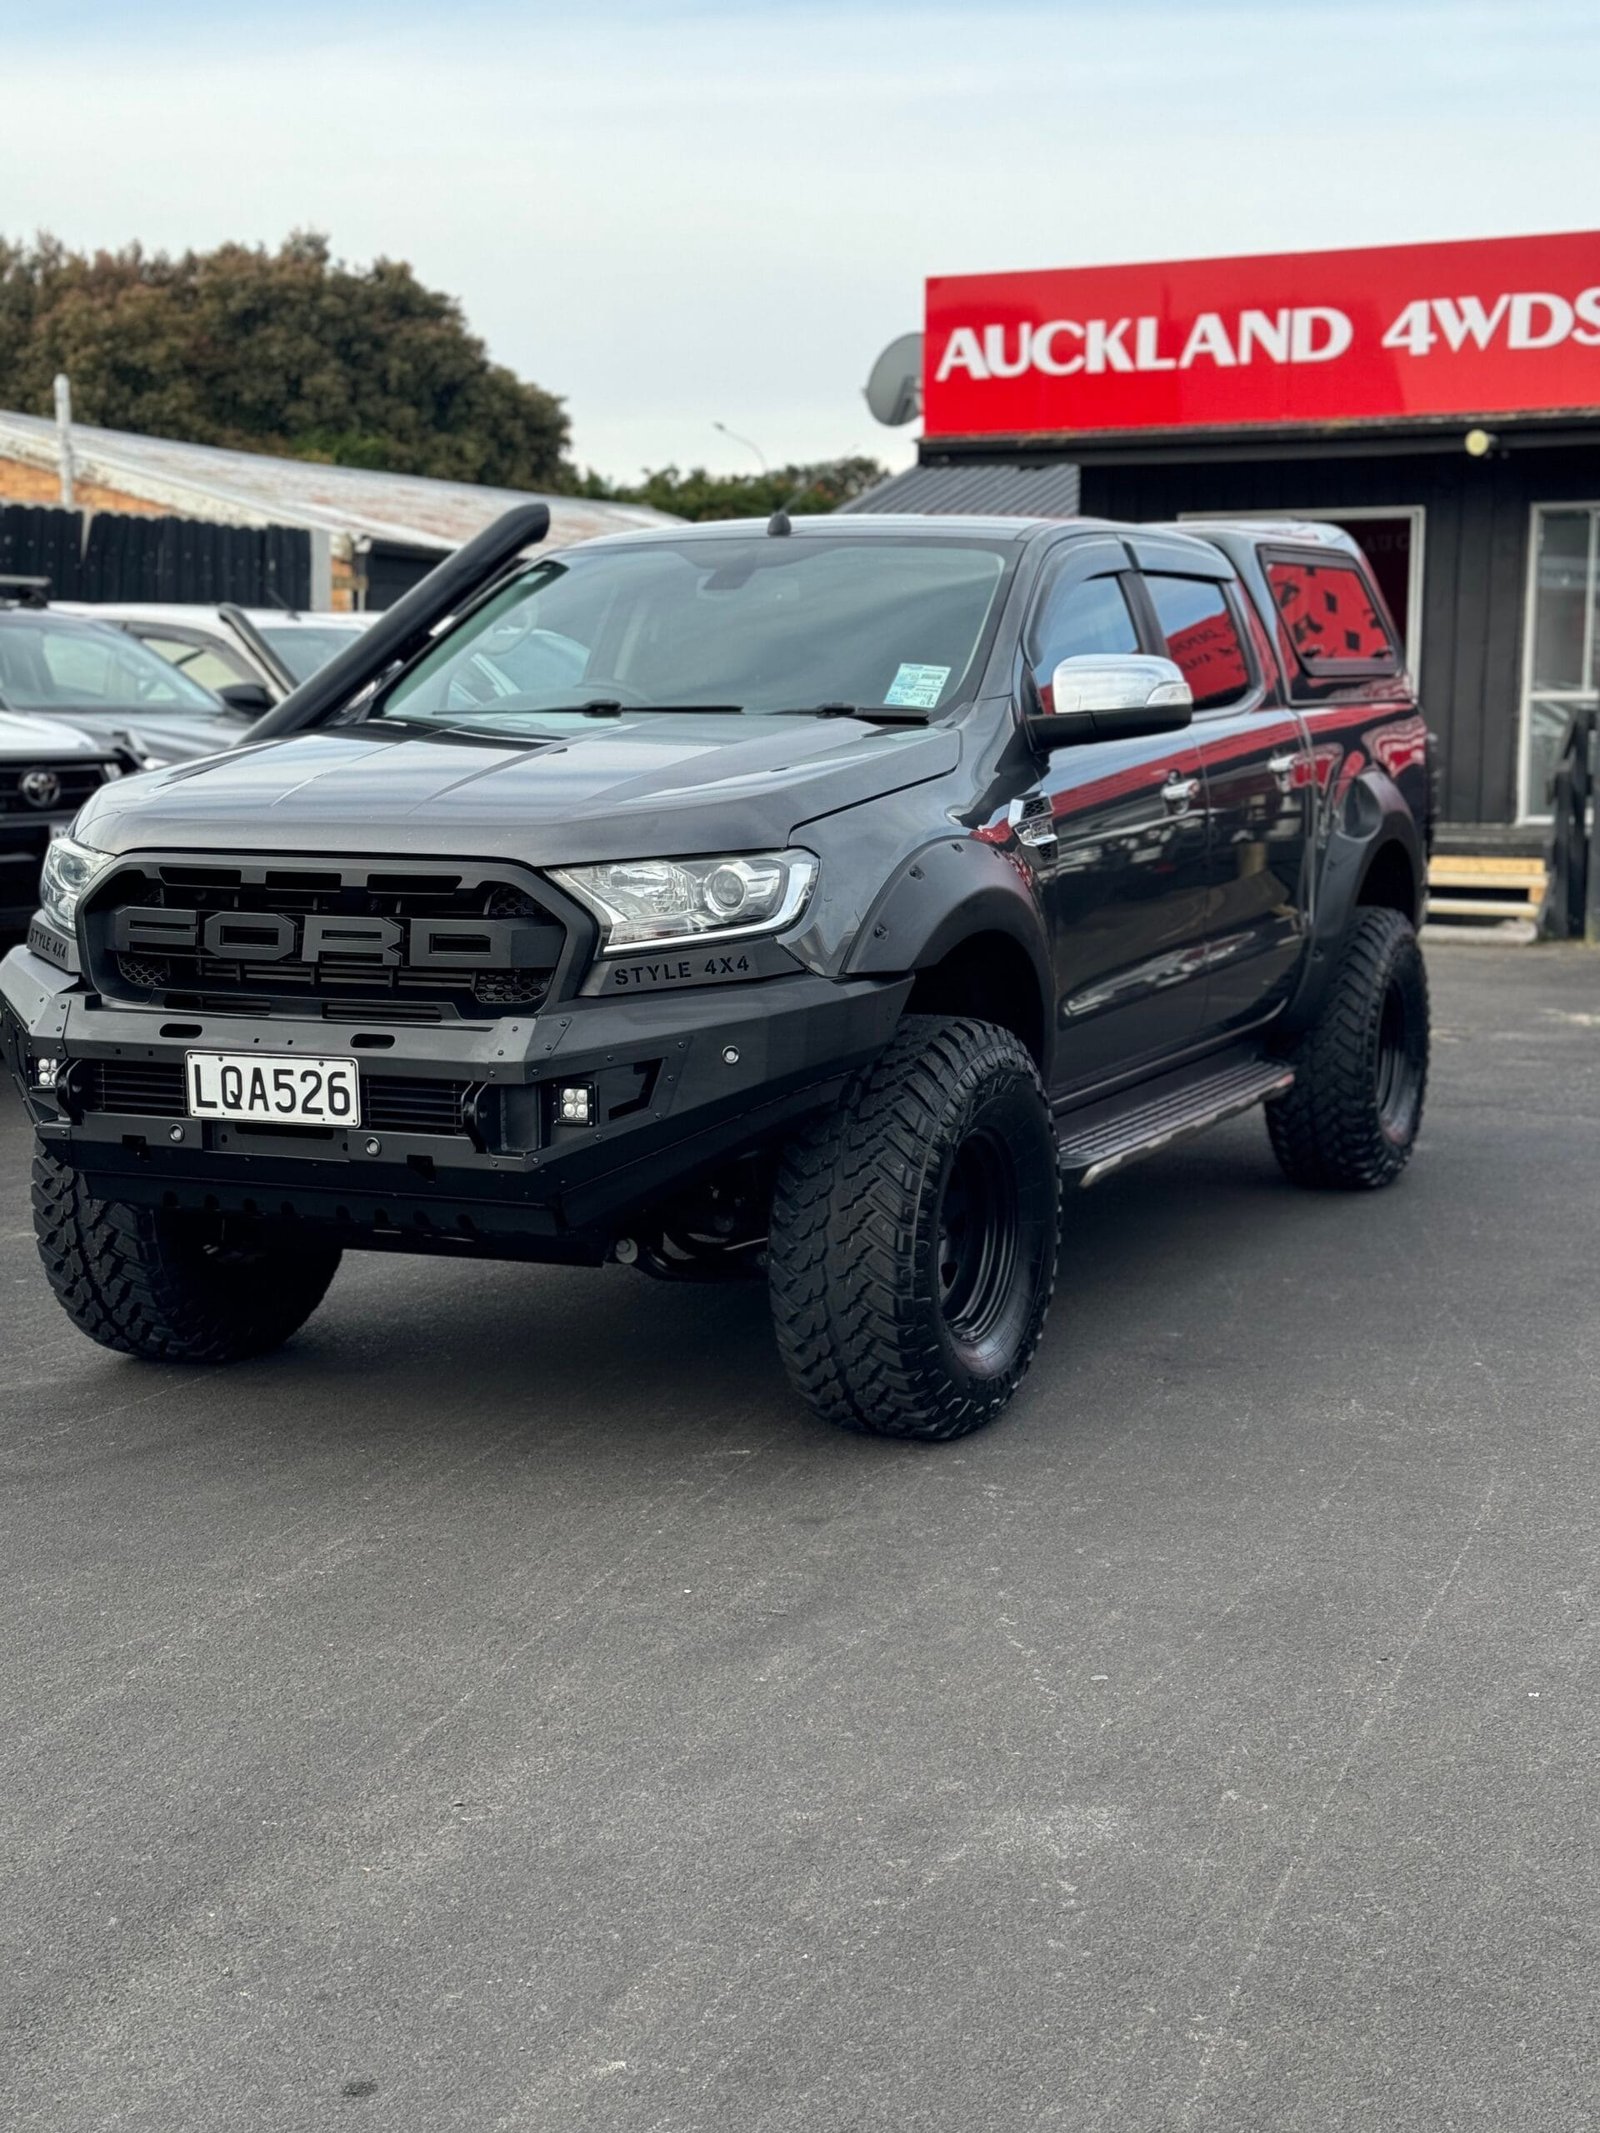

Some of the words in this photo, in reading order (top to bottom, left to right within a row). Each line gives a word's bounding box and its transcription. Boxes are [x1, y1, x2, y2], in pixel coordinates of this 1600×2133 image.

[935, 306, 1354, 382] AUCKLAND
[29, 928, 51, 952] STYLE
[115, 905, 513, 968] FORD
[614, 961, 691, 986] STYLE
[704, 955, 749, 975] 4X4
[194, 1064, 351, 1116] LQA526
